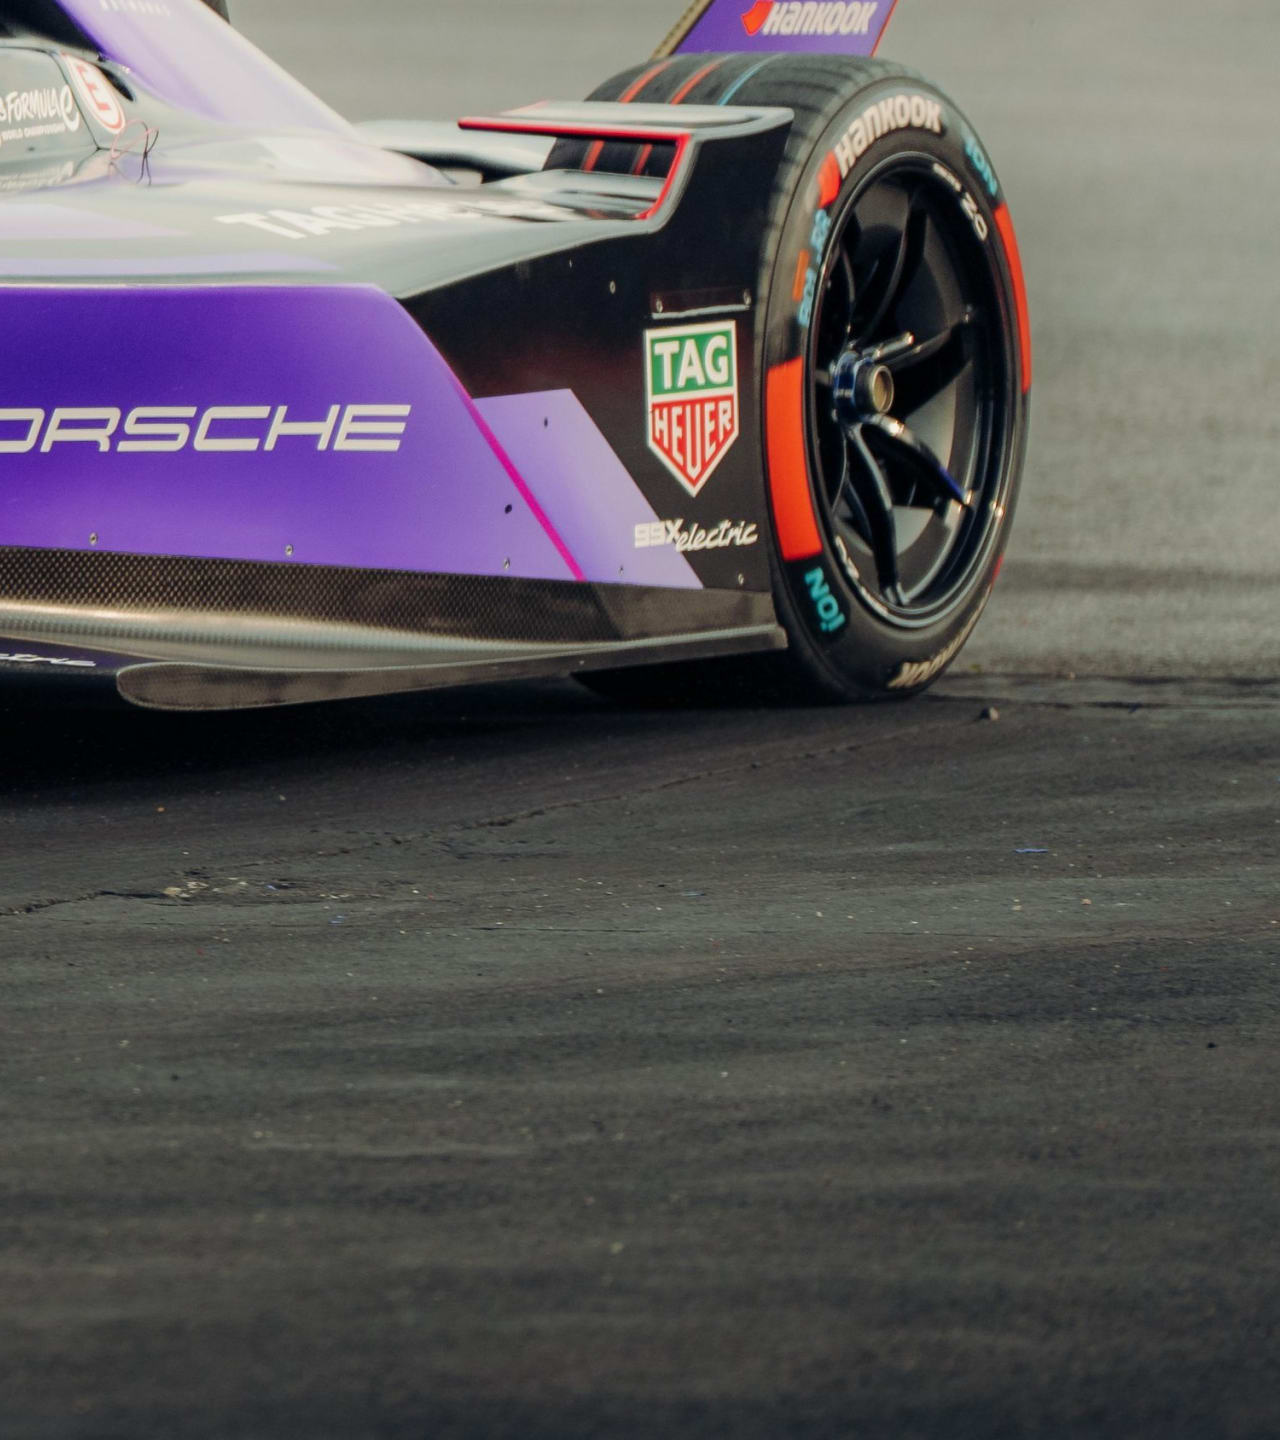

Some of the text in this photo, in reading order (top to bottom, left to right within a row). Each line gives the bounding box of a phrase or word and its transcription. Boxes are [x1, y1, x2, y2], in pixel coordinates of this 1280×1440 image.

[6, 88, 62, 125] FORMULA
[654, 335, 729, 390] TAG
[654, 399, 732, 479] HEUER
